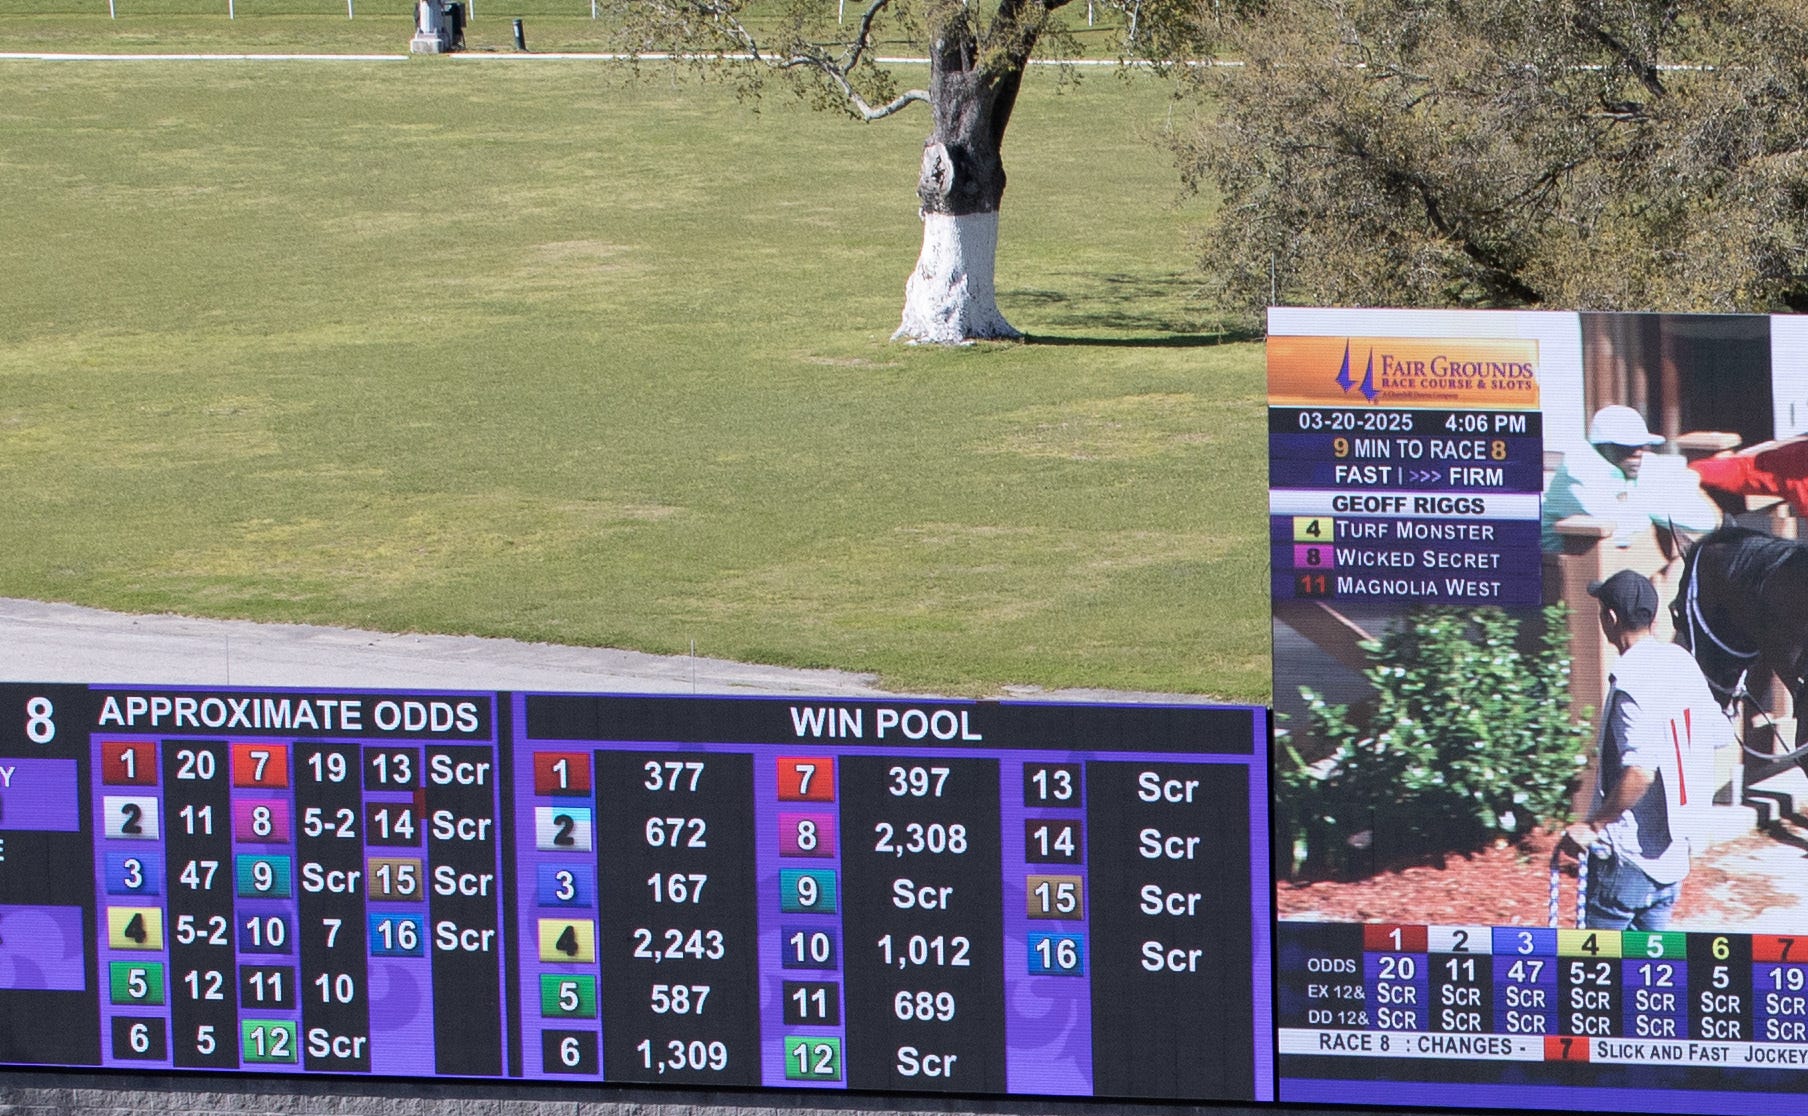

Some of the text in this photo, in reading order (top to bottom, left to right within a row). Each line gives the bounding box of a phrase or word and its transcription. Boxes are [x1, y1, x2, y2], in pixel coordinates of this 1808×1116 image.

[1382, 378, 1532, 390] RACE COURSE & SLOTS
[1430, 355, 1534, 378] GROUNDS
[1299, 412, 1526, 432] 03-20-2025 4:06 PM
[1333, 438, 1507, 460] 9 MIN TO RACE 8
[1335, 465, 1503, 486] FAST FIRM
[1332, 495, 1485, 515] GEOFF RIGGS
[1306, 519, 1321, 537] 4
[1306, 548, 1321, 566] 8
[1302, 576, 1327, 593] 11
[26, 696, 55, 744] 8
[98, 696, 478, 732] APPROXIMATE ODDS
[790, 706, 982, 740] WIN POOL
[120, 748, 411, 784] 1 20 7 19 13
[553, 759, 950, 797] 1 377 7 397
[121, 803, 414, 839] 2 11 8 5-2 14
[553, 814, 967, 858] 2 672 8 2,308
[124, 858, 416, 895] 3 47 9 Scr 15
[556, 870, 953, 910] 3 167 9 Scr
[124, 913, 417, 950] 4 5-2 10 7 16
[555, 925, 970, 970] 4 2,243 10 1,012
[1390, 928, 1402, 951] 1
[1453, 930, 1469, 952] 2
[1518, 932, 1534, 954] 3
[1582, 933, 1600, 956] 4
[1647, 935, 1664, 958] 5
[1712, 937, 1729, 960] 6
[128, 968, 354, 1003] 5 12 11 10
[1307, 958, 1357, 974] ODDS
[1378, 956, 1416, 980] 20
[1445, 959, 1476, 982] 11
[1507, 960, 1545, 984] 47
[1570, 961, 1612, 986] 5-2
[1637, 964, 1674, 987] 12
[1711, 966, 1729, 989] 5
[1769, 967, 1804, 991] 19
[559, 982, 955, 1021] 5 587 11 689
[1307, 984, 1366, 1000] EX 12&
[1308, 1010, 1370, 1027] DD 12&
[130, 1023, 366, 1058] 6 5 12 Scr
[560, 1036, 957, 1077] 6 1,309 12 Scr
[1319, 1033, 1373, 1051] RACE
[1380, 1035, 1391, 1052] 8
[1417, 1036, 1513, 1055] CHANGES
[1559, 1038, 1574, 1059] 7
